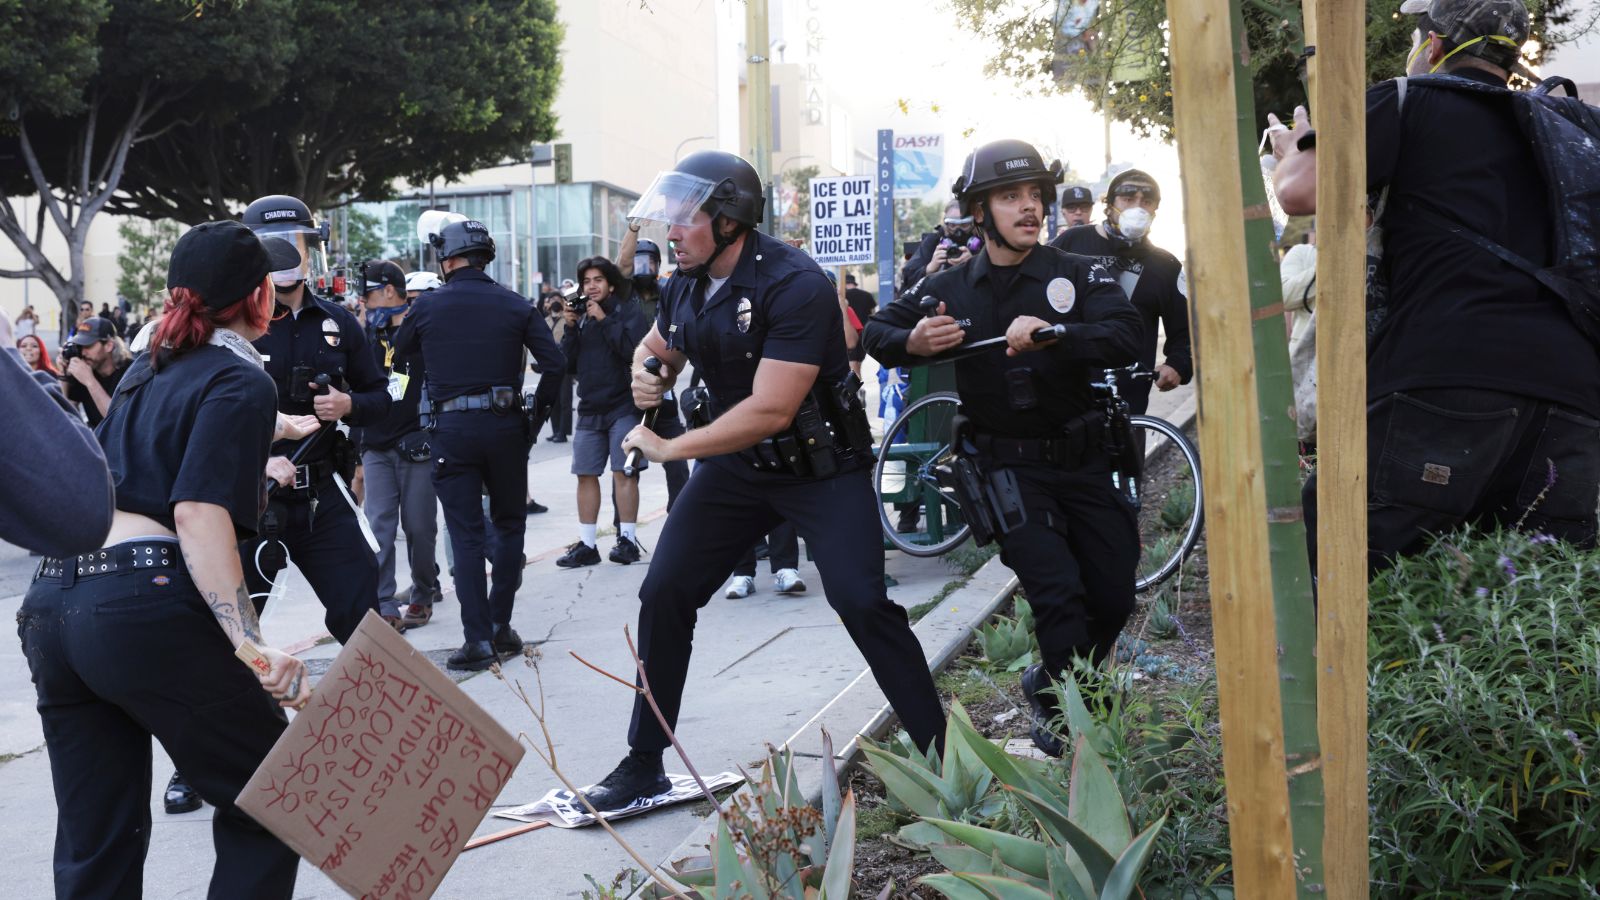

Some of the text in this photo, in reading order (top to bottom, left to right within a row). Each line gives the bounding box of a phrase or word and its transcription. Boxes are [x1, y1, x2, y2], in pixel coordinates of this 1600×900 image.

[895, 135, 940, 148] DASH
[1005, 158, 1029, 170] FARIAS
[881, 142, 890, 206] LADOT
[813, 180, 871, 198] ICE OUT
[264, 209, 297, 220] CHADWICK
[814, 198, 871, 219] OF LA!
[815, 222, 872, 239] END THE
[814, 237, 872, 254] VIOLENT
[815, 254, 872, 264] CRIMINAL RAIDS!
[251, 657, 270, 672] ACE
[305, 673, 419, 837] FLOURISH
[361, 727, 487, 900] AS OUR HEAR
[394, 751, 513, 900] FOR AS LON
